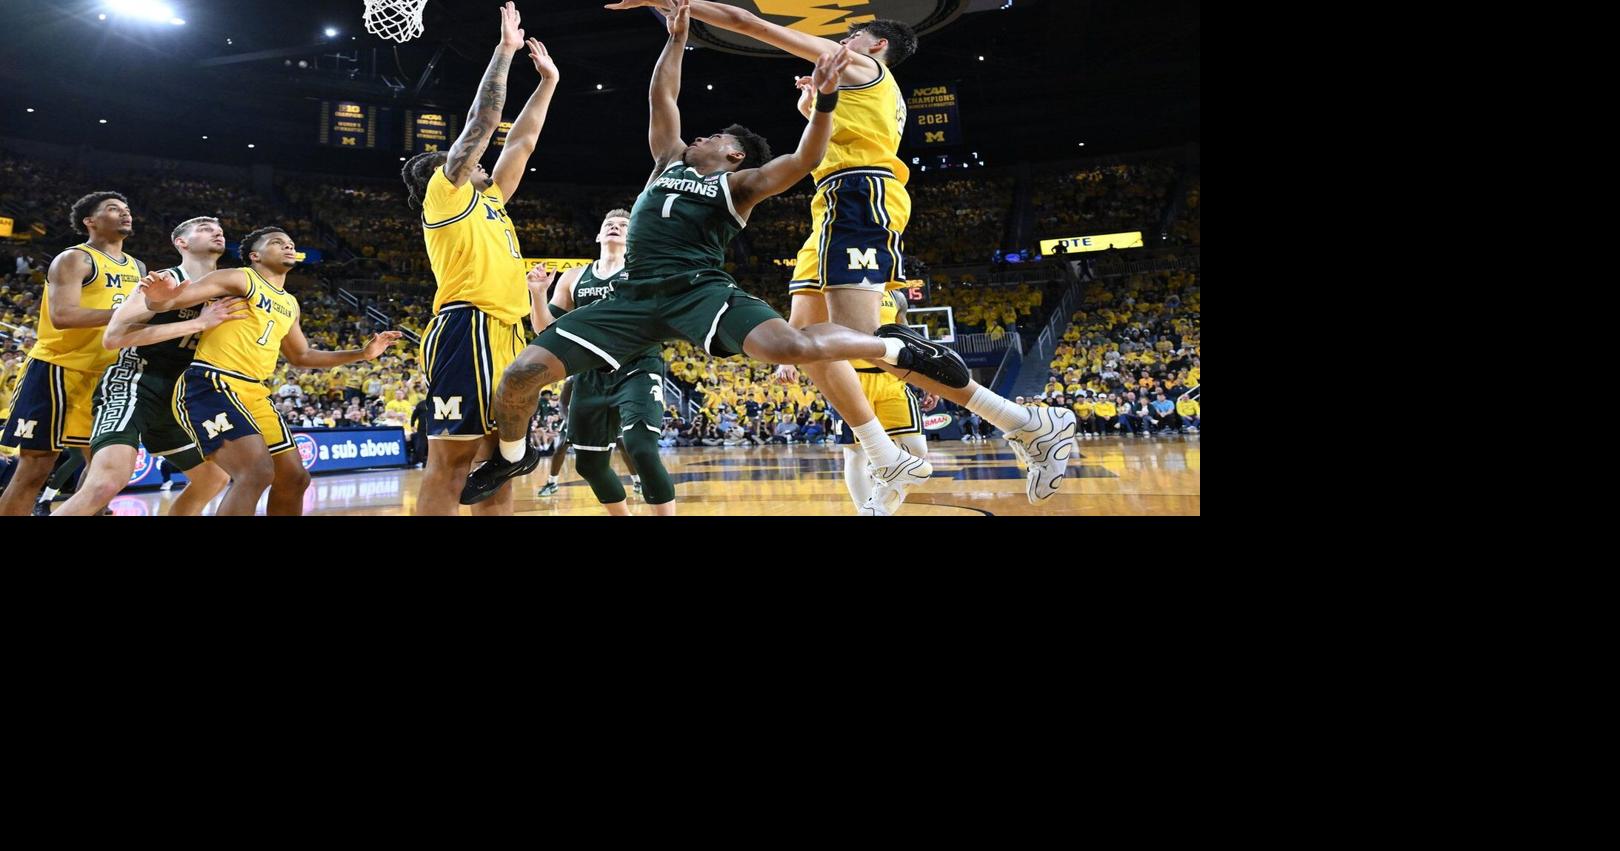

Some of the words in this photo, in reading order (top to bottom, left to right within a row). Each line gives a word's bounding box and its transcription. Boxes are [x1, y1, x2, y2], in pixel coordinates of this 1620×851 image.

[907, 94, 956, 105] CHAMPIONS
[913, 86, 947, 97] NCAA
[918, 113, 949, 126] 2021
[925, 131, 945, 143] M
[662, 193, 682, 218] 1
[504, 229, 521, 259] 1
[846, 247, 880, 270] M
[908, 287, 923, 300] 15
[256, 319, 275, 346] 1
[432, 396, 463, 420] M
[13, 418, 38, 439] M
[201, 411, 234, 440] M
[319, 444, 330, 460] a
[331, 440, 358, 460] sub
[360, 439, 400, 458] above
